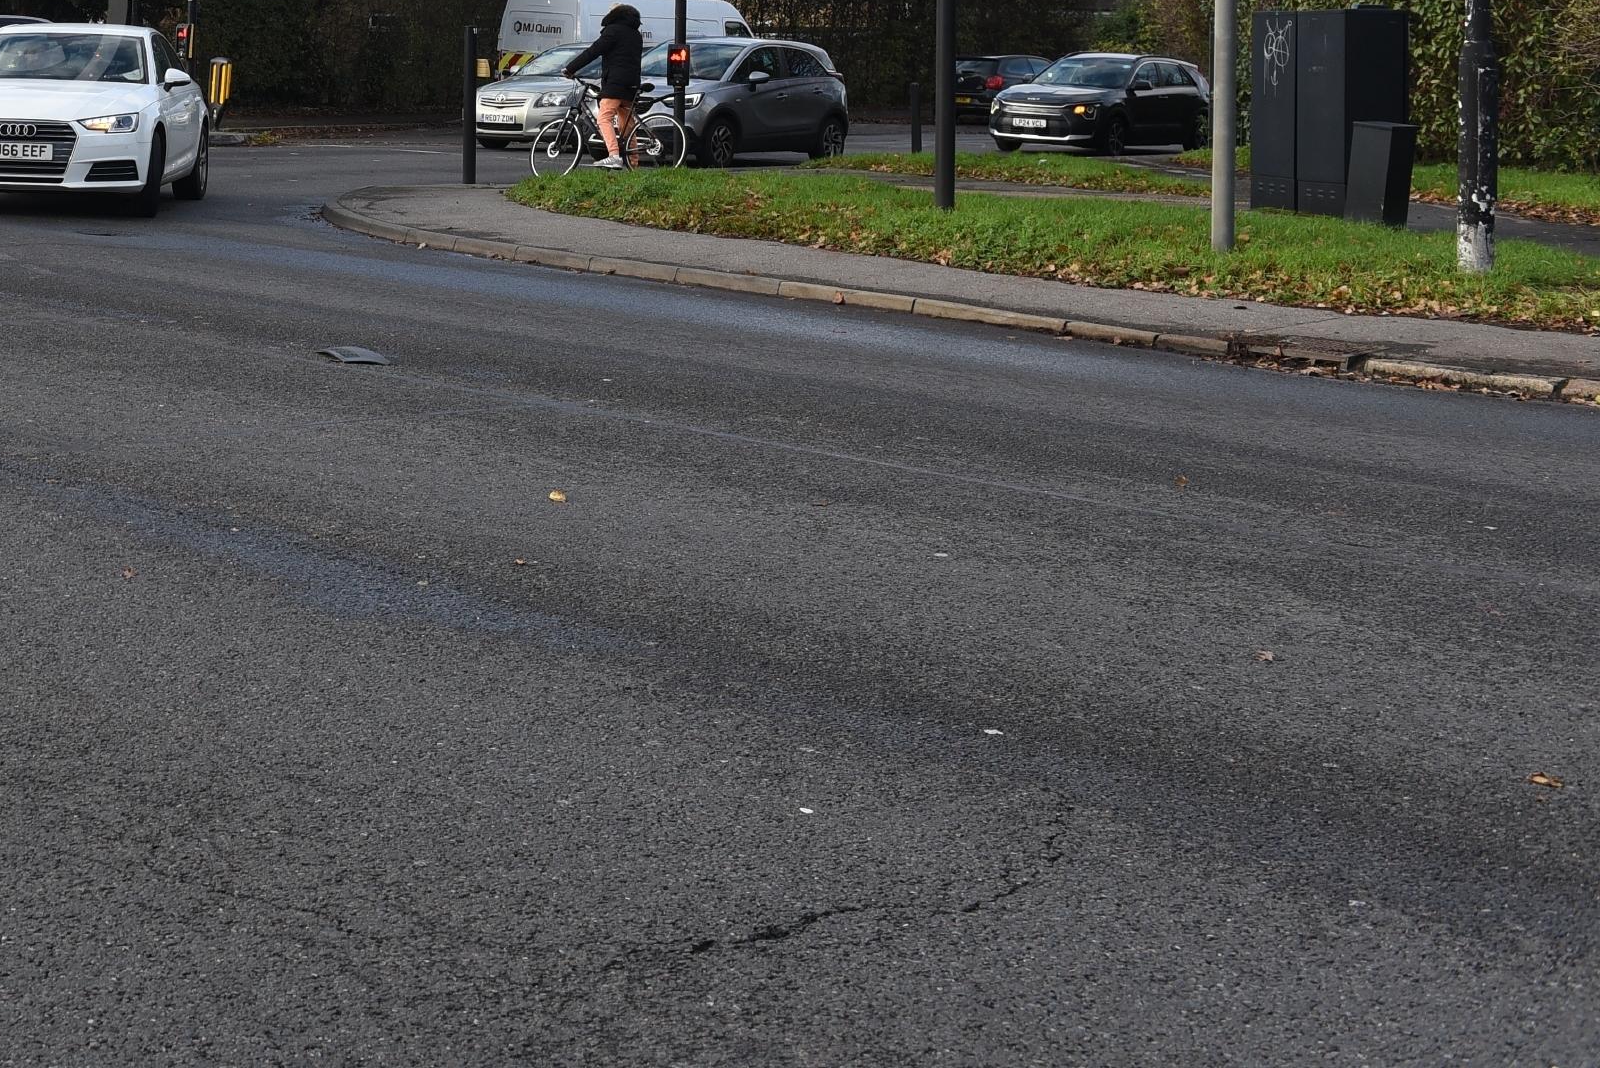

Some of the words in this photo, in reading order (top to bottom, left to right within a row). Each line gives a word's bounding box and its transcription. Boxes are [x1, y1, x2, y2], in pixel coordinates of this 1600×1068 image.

[522, 23, 535, 32] MJ
[536, 23, 562, 34] Quinn
[22, 145, 47, 157] EEF
